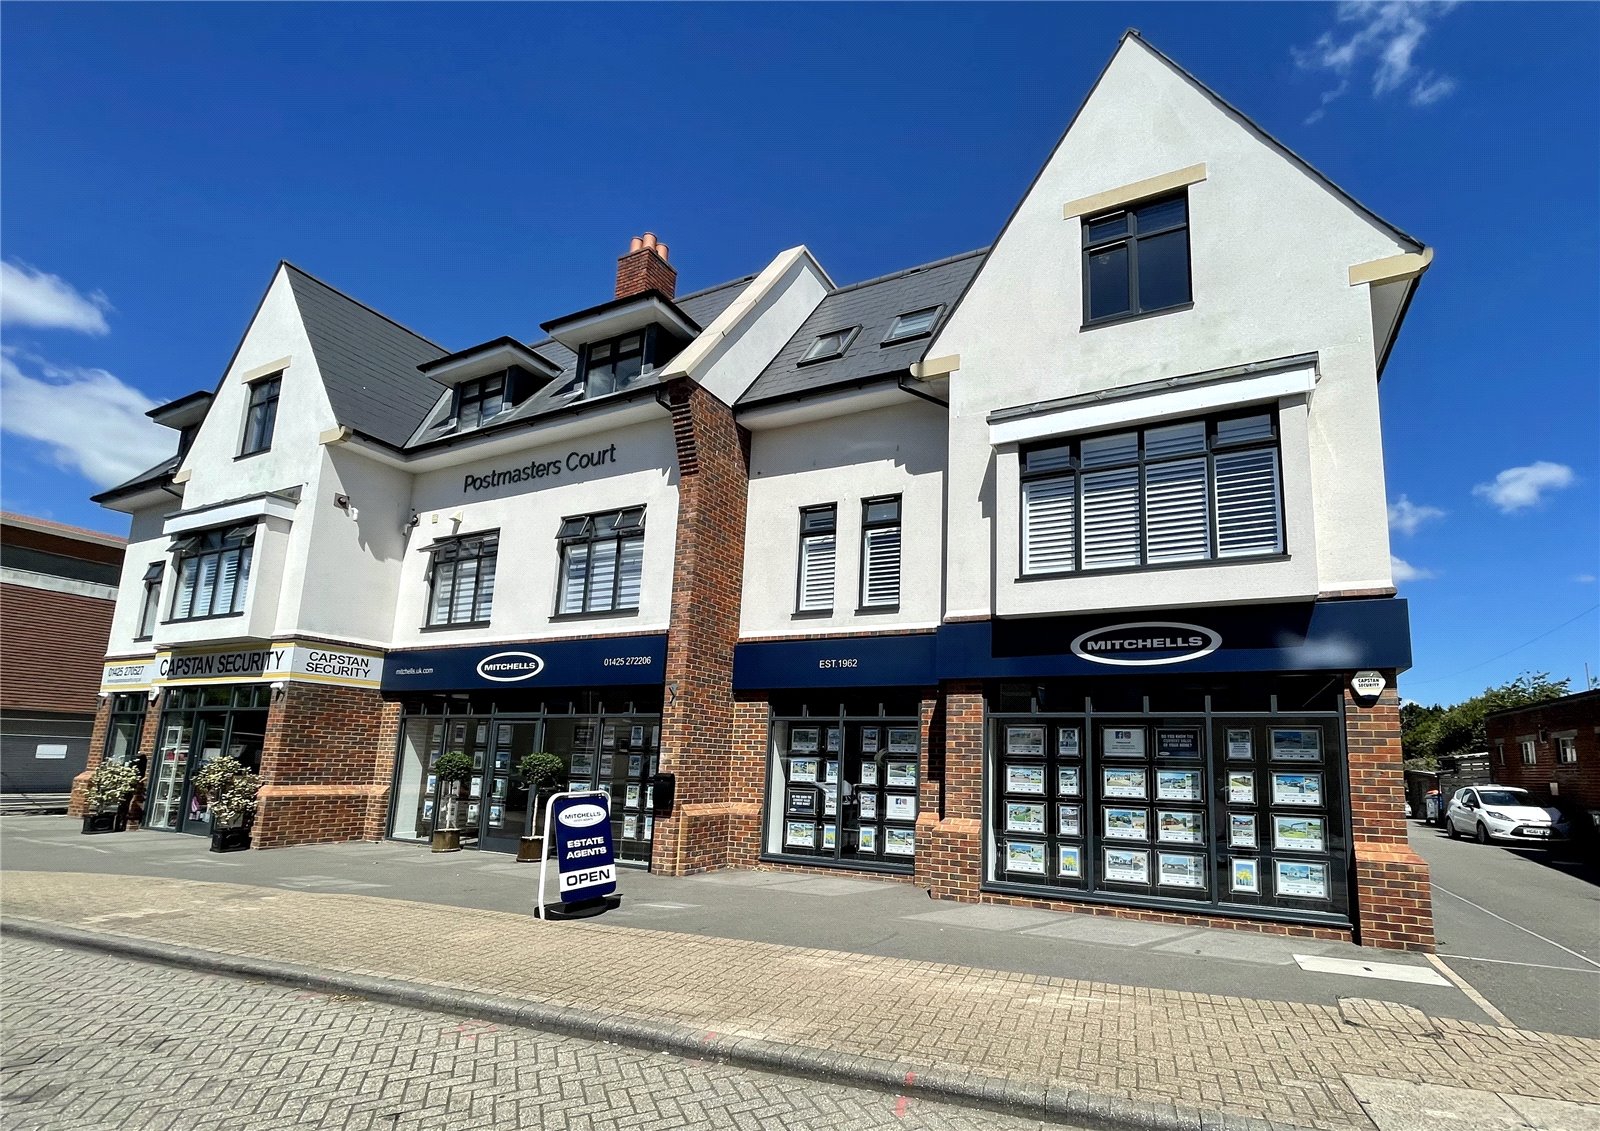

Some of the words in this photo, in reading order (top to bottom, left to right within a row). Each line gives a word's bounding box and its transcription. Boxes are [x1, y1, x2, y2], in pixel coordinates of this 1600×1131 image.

[463, 459, 562, 493] Postmasters
[566, 443, 617, 472] Court
[1086, 635, 1203, 651] MITCHELLS
[159, 655, 214, 677] CAPSTAN
[216, 650, 285, 674] SECURITY
[308, 651, 369, 668] CAPSTAN
[483, 661, 536, 672] MITCHELLS
[603, 657, 624, 667] 01425
[625, 655, 652, 666] 272206
[305, 662, 371, 679] SECURITY
[564, 811, 601, 819] MITCHELLS
[567, 836, 604, 848] ESTATE
[566, 846, 607, 859] AGENTS
[566, 869, 610, 886] OPEN
